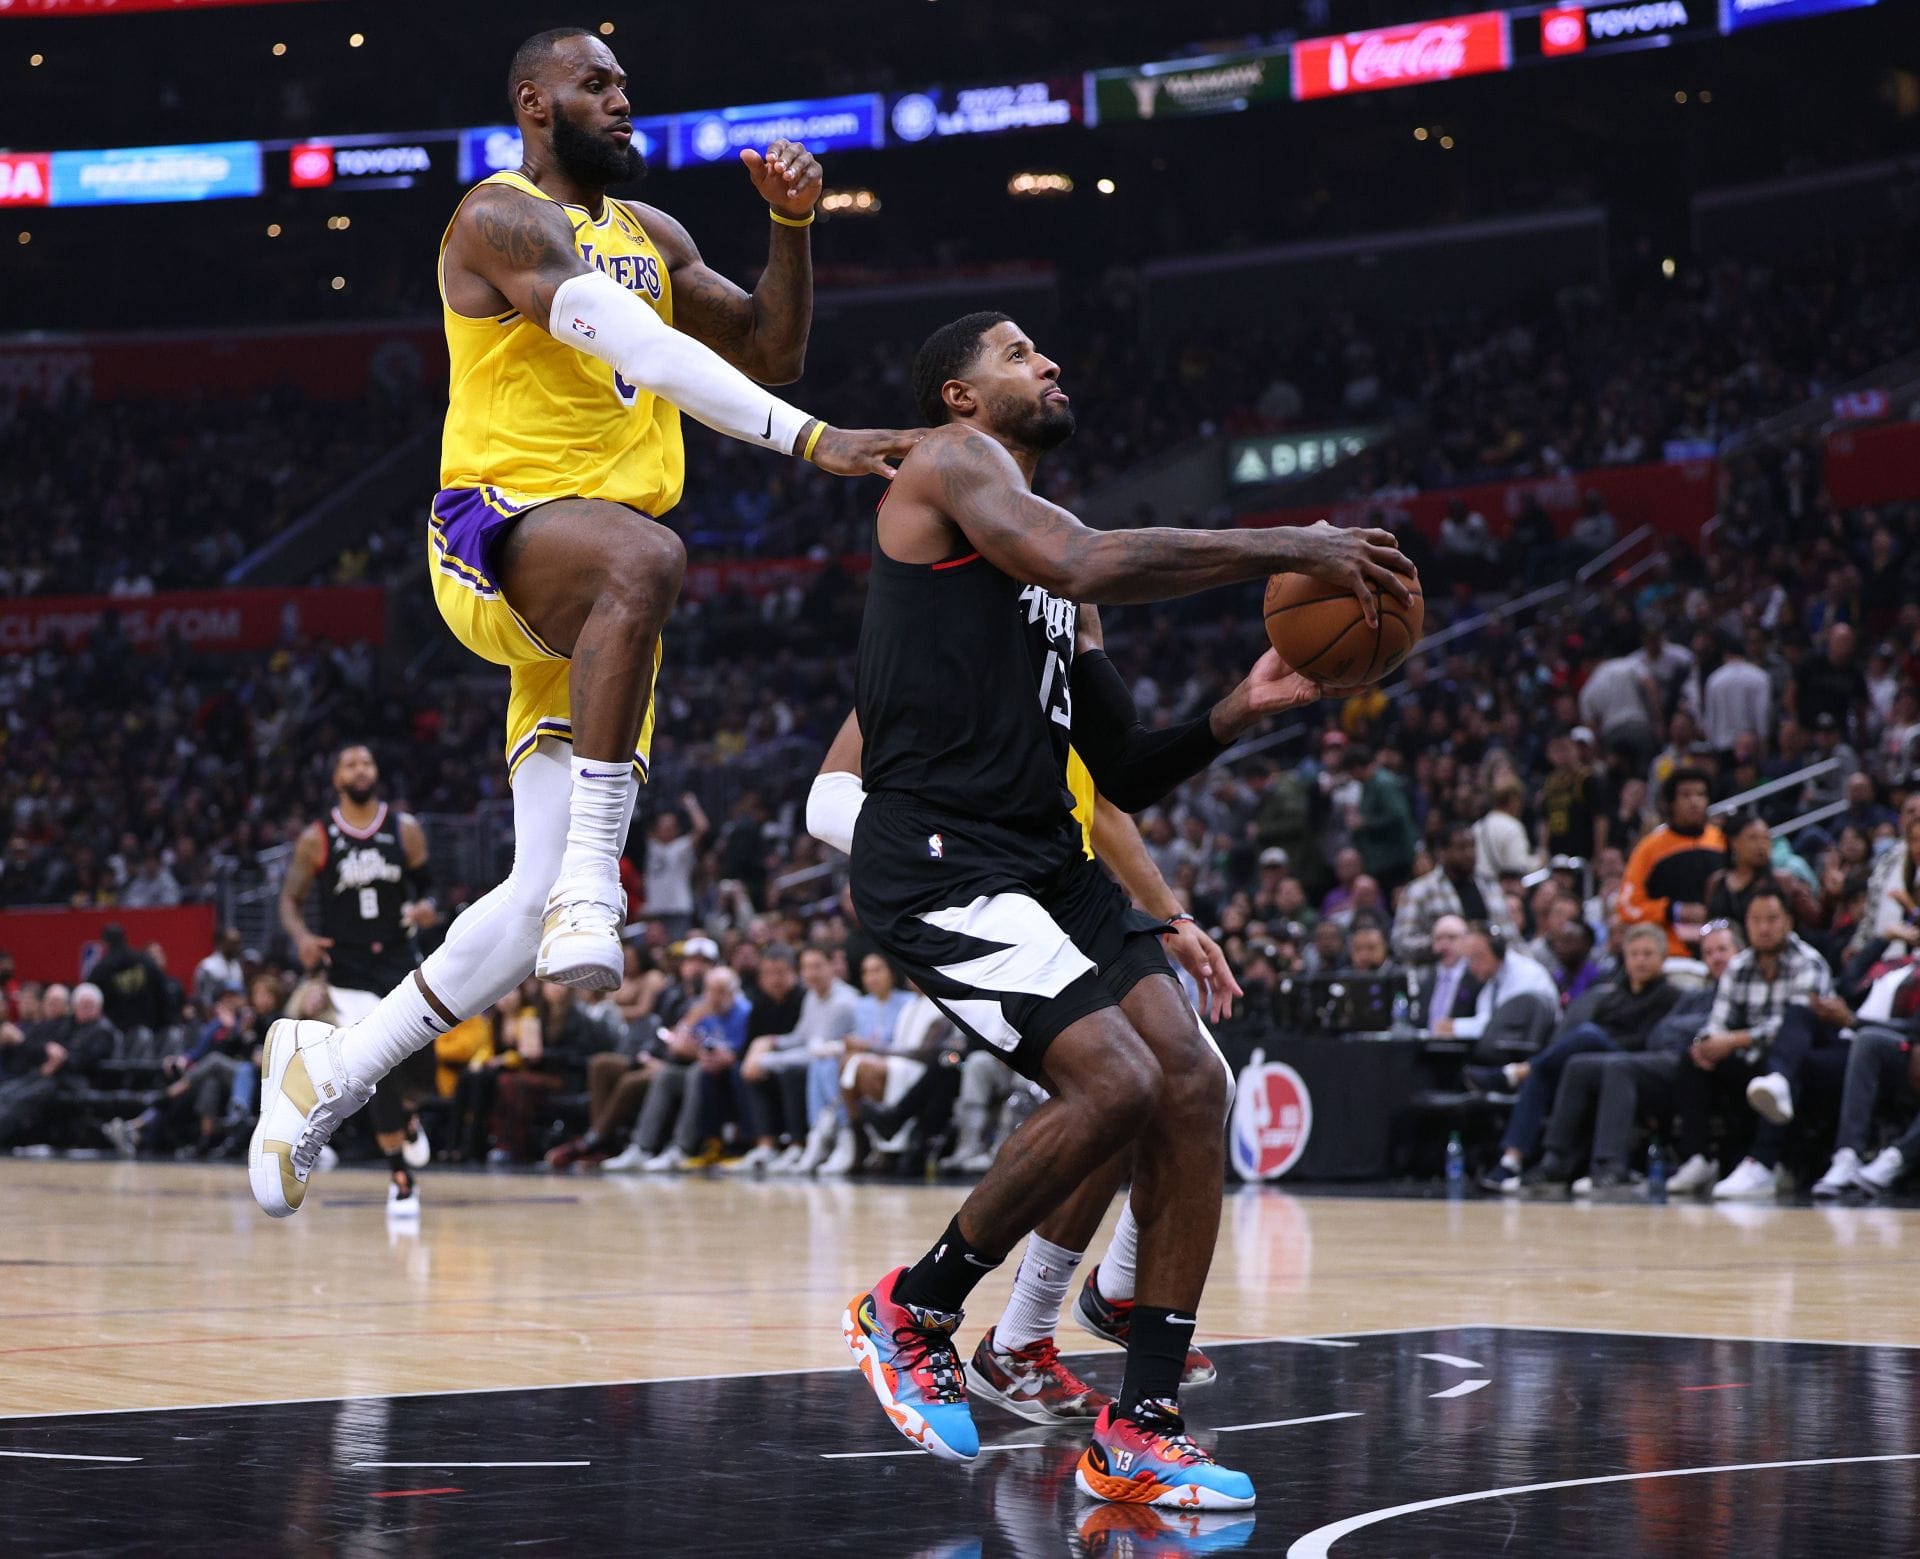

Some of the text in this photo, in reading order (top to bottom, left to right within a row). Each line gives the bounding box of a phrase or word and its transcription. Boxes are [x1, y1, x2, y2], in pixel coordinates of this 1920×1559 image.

[1588, 1, 1687, 38] TOYOTA
[334, 147, 431, 175] TOYOTA
[1116, 1450, 1134, 1472] 13
